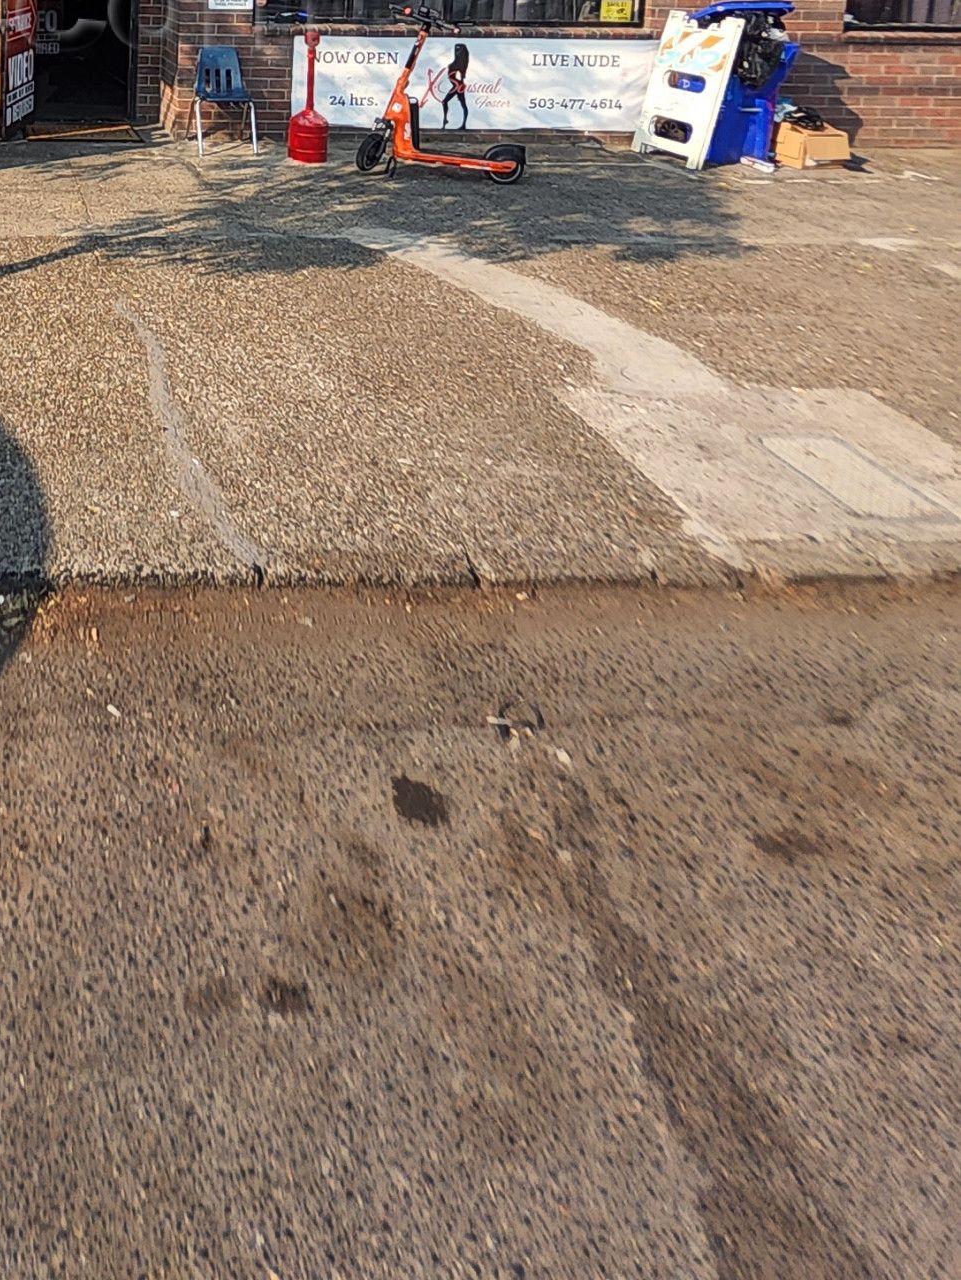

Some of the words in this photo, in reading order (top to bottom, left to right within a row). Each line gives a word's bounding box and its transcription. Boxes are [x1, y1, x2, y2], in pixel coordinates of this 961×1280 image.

[354, 51, 399, 64] OPEN
[532, 53, 569, 67] LIVE
[573, 54, 621, 68] NUDE
[8, 48, 34, 91] VIDEO
[329, 95, 345, 107] 24
[350, 93, 378, 107] hrs.
[528, 98, 623, 110] 503-477-4614
